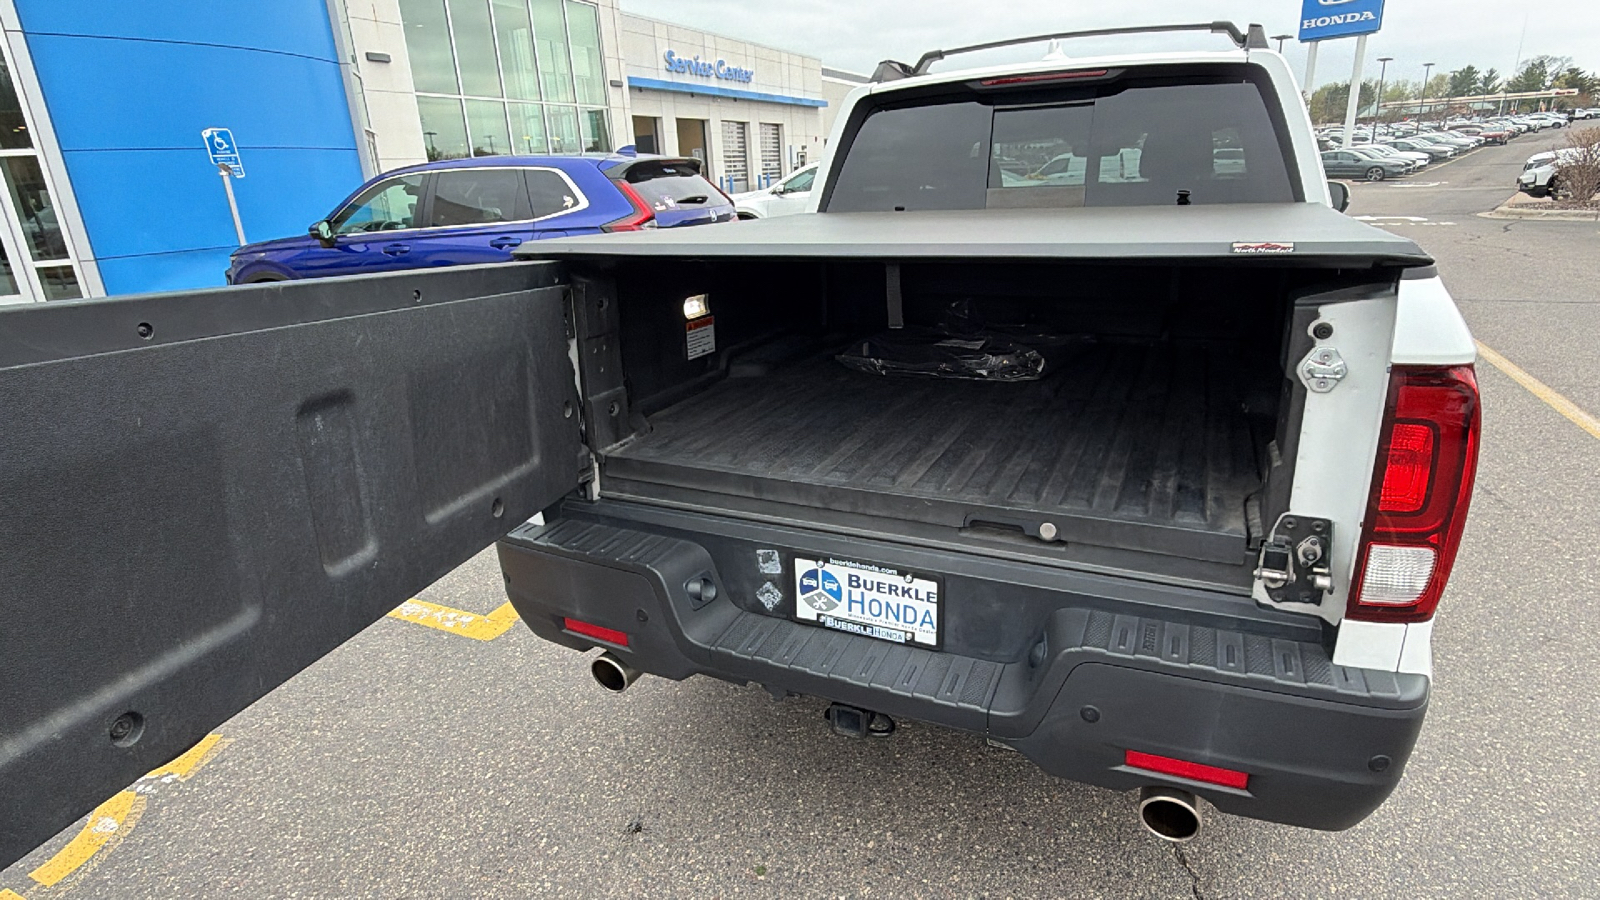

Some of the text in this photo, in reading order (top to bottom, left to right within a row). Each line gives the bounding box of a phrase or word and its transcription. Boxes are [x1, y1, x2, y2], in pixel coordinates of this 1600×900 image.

[1302, 11, 1376, 29] HONDA
[664, 50, 754, 83] Service Center
[829, 557, 898, 576] buerklehonda.com
[848, 573, 937, 604] BUERKLE
[848, 589, 936, 630] HONDA
[827, 616, 904, 641] BUERKLE HONDA
